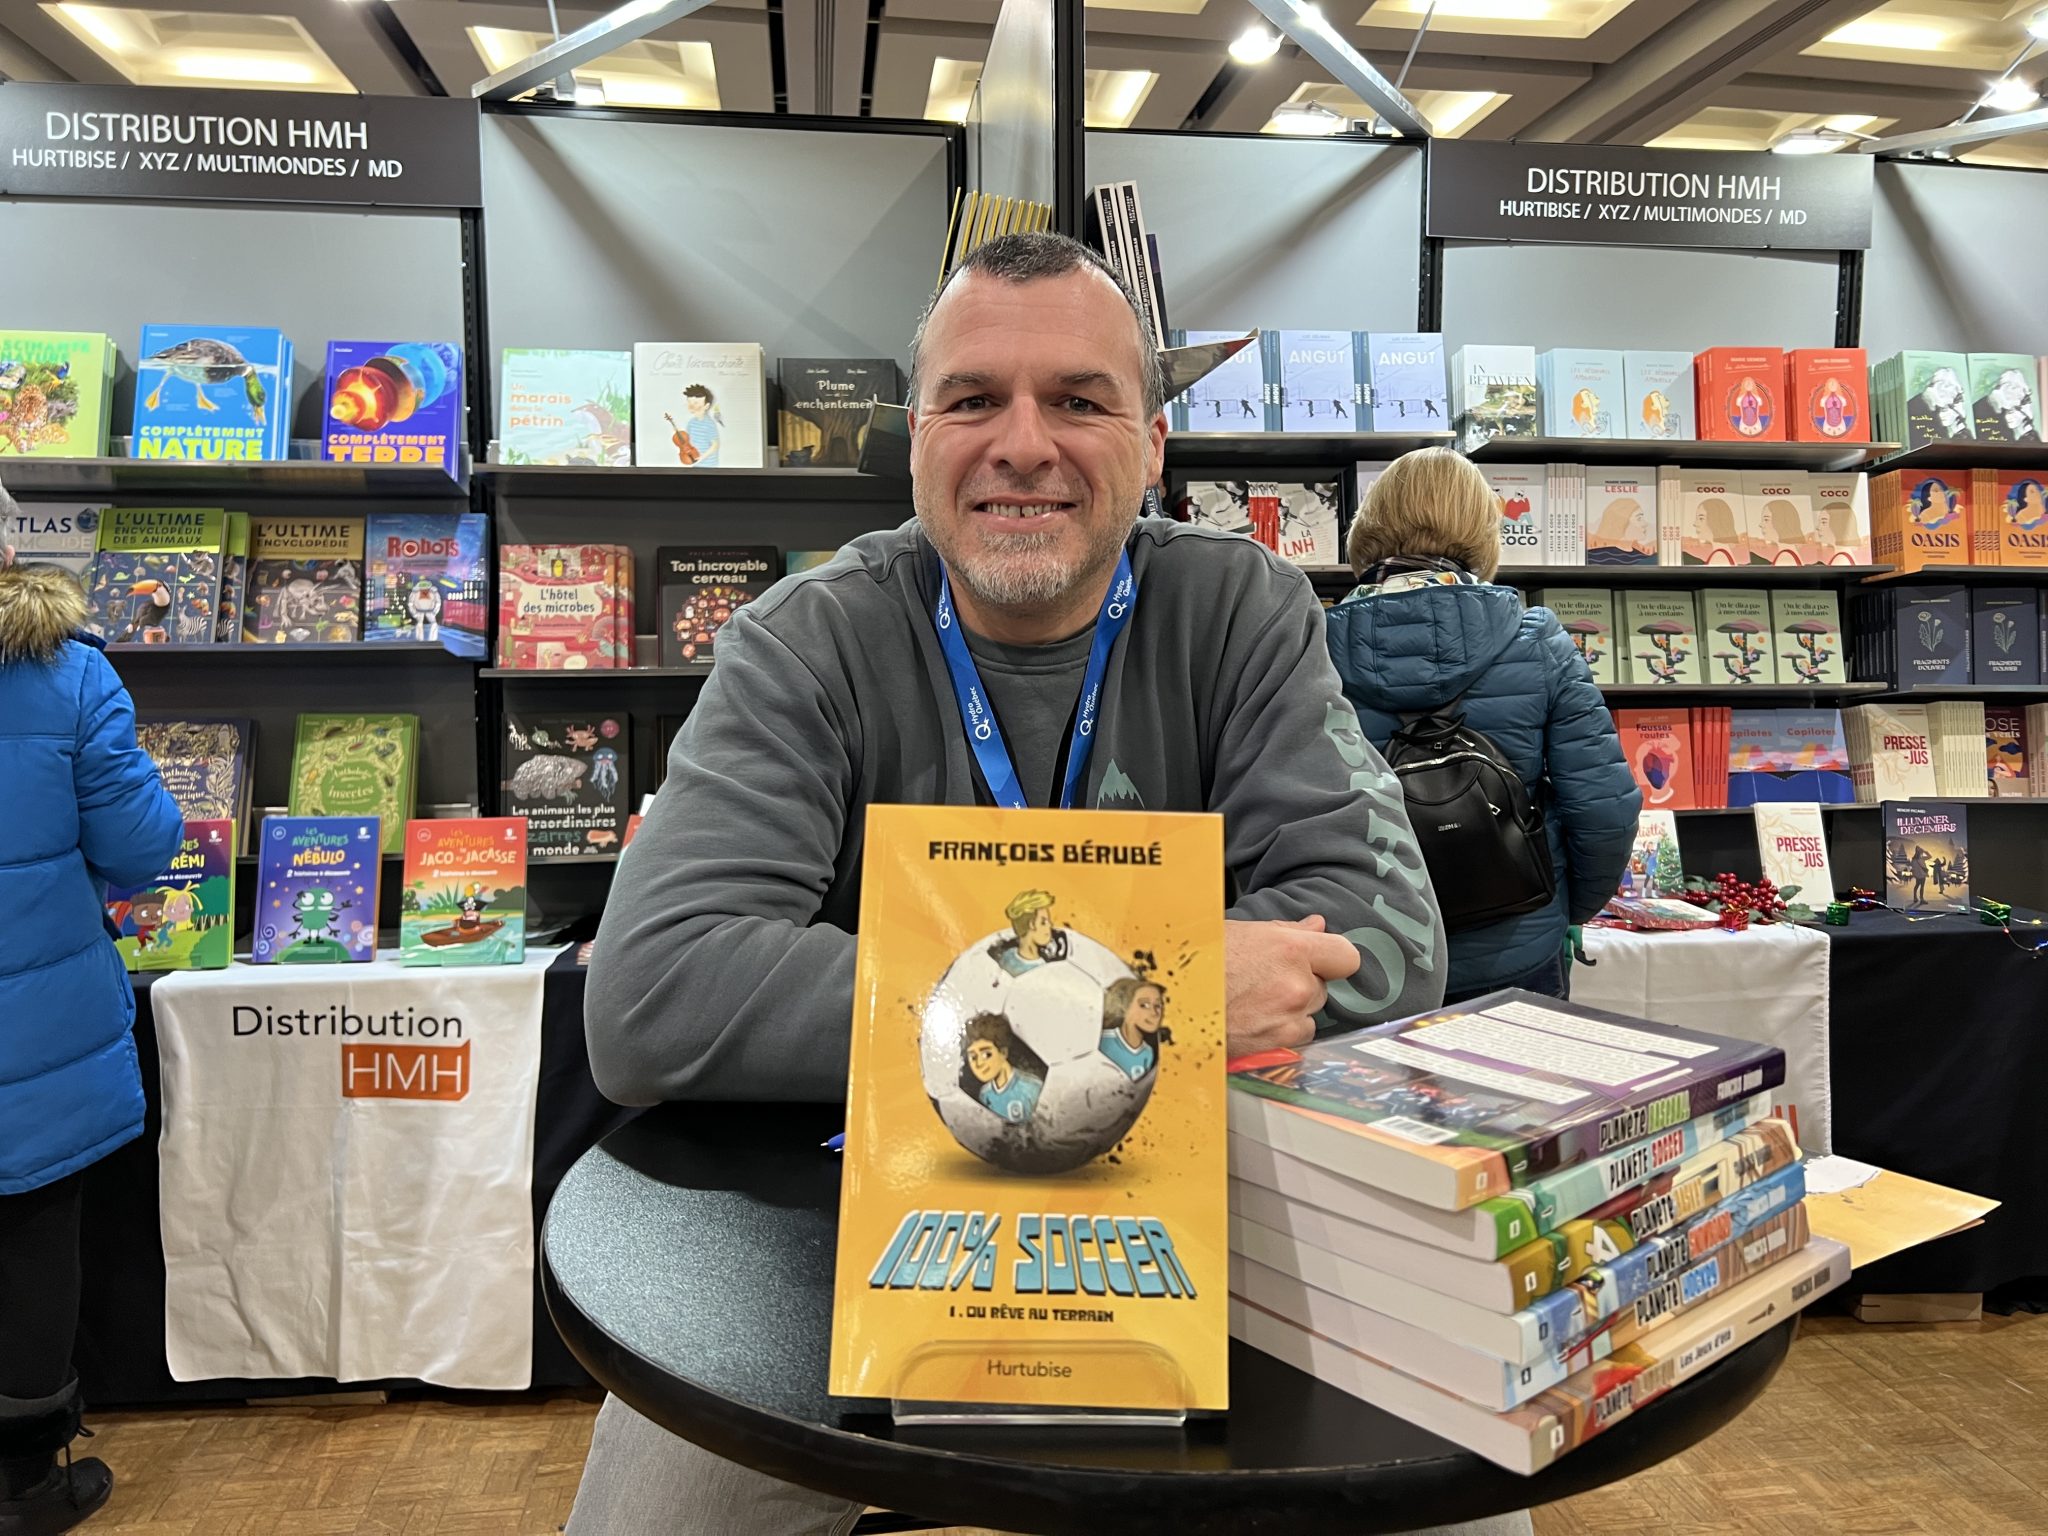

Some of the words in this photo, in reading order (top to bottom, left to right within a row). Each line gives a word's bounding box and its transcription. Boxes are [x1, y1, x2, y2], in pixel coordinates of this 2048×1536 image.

[46, 111, 279, 147] DISTRIBUTION
[288, 120, 368, 150] HMH
[12, 148, 117, 170] HURTIBISE
[140, 153, 180, 172] XYZ
[197, 154, 347, 178] MULTIMONDES
[368, 159, 403, 178] MD
[1527, 167, 1710, 200] DISTRIBUTION
[1718, 175, 1781, 201] HMH
[1499, 199, 1581, 220] HURTIBISE
[1598, 204, 1630, 221] XYZ
[1643, 205, 1762, 226] MULTIMONDES
[1779, 209, 1807, 226] MD
[1289, 350, 1346, 365] ANGUT
[1379, 352, 1436, 365] ANGUT
[1473, 364, 1485, 374] IN
[816, 380, 855, 390] Plume
[1469, 374, 1535, 386] BETWEEN
[510, 394, 572, 404] marais
[793, 398, 874, 410] enchantemen
[510, 415, 563, 428] pétrin
[138, 438, 263, 461] NATURE
[1605, 485, 1638, 493] LESLIE
[11, 517, 72, 533] TLAS
[116, 513, 205, 526] L'ULTIME
[114, 526, 204, 535] ENCYCLOPÉDIE
[258, 524, 350, 538] L'ULTIME
[1301, 530, 1312, 538] LA
[113, 536, 137, 544] DES
[142, 536, 202, 544] ANIMAUX
[257, 538, 349, 548] ENCYCLOPÉDIE
[1283, 537, 1315, 557] LNH
[1912, 534, 1960, 547] OASIS
[671, 561, 695, 571] Ton
[698, 560, 768, 573] incroyable
[692, 575, 747, 583] cerveau
[541, 589, 578, 600] L'hôtel
[1113, 580, 1125, 601] Hydro
[524, 602, 541, 613] des
[545, 602, 594, 612] microbes
[970, 686, 983, 714] Québec
[1089, 683, 1099, 712] Québec
[968, 703, 979, 724] Hydro
[1083, 695, 1092, 718] Hydro
[1636, 724, 1672, 732] Fausses
[1985, 718, 2020, 731] OSE
[1730, 728, 1772, 738] opilotes
[1787, 727, 1836, 737] Copilotes
[1884, 736, 1927, 750] PRESSE
[1904, 751, 1929, 765] -JUS
[329, 785, 374, 799] insectes
[512, 806, 529, 816] Les
[532, 805, 575, 815] animaux
[578, 804, 588, 815] les
[594, 803, 616, 818] plus
[528, 816, 616, 829] traordinaires
[1897, 815, 1949, 826] ILLUMINER
[292, 832, 350, 846] AVENTURES
[437, 834, 495, 848] AVENTURES
[528, 830, 581, 842] zarres
[533, 842, 580, 856] monde
[1776, 837, 1821, 852] PRESSE
[293, 848, 345, 866] NÉBULO
[419, 851, 454, 866] JACO
[463, 848, 517, 864] JACASSE
[1063, 840, 1162, 866] BÉRUBÉ
[170, 851, 205, 870] RÉMI
[1798, 853, 1824, 868] -JUS
[232, 1005, 462, 1039] Distribution
[348, 1052, 462, 1093] HMH
[868, 1209, 1002, 1291] 100%
[1013, 1213, 1197, 1299] SOCCER
[966, 1306, 986, 1319] DU
[990, 1303, 1025, 1320] RÊVE
[1029, 1308, 1048, 1321] AU
[1053, 1309, 1114, 1323] TERRAIN
[987, 1359, 1072, 1379] Hurtubise
